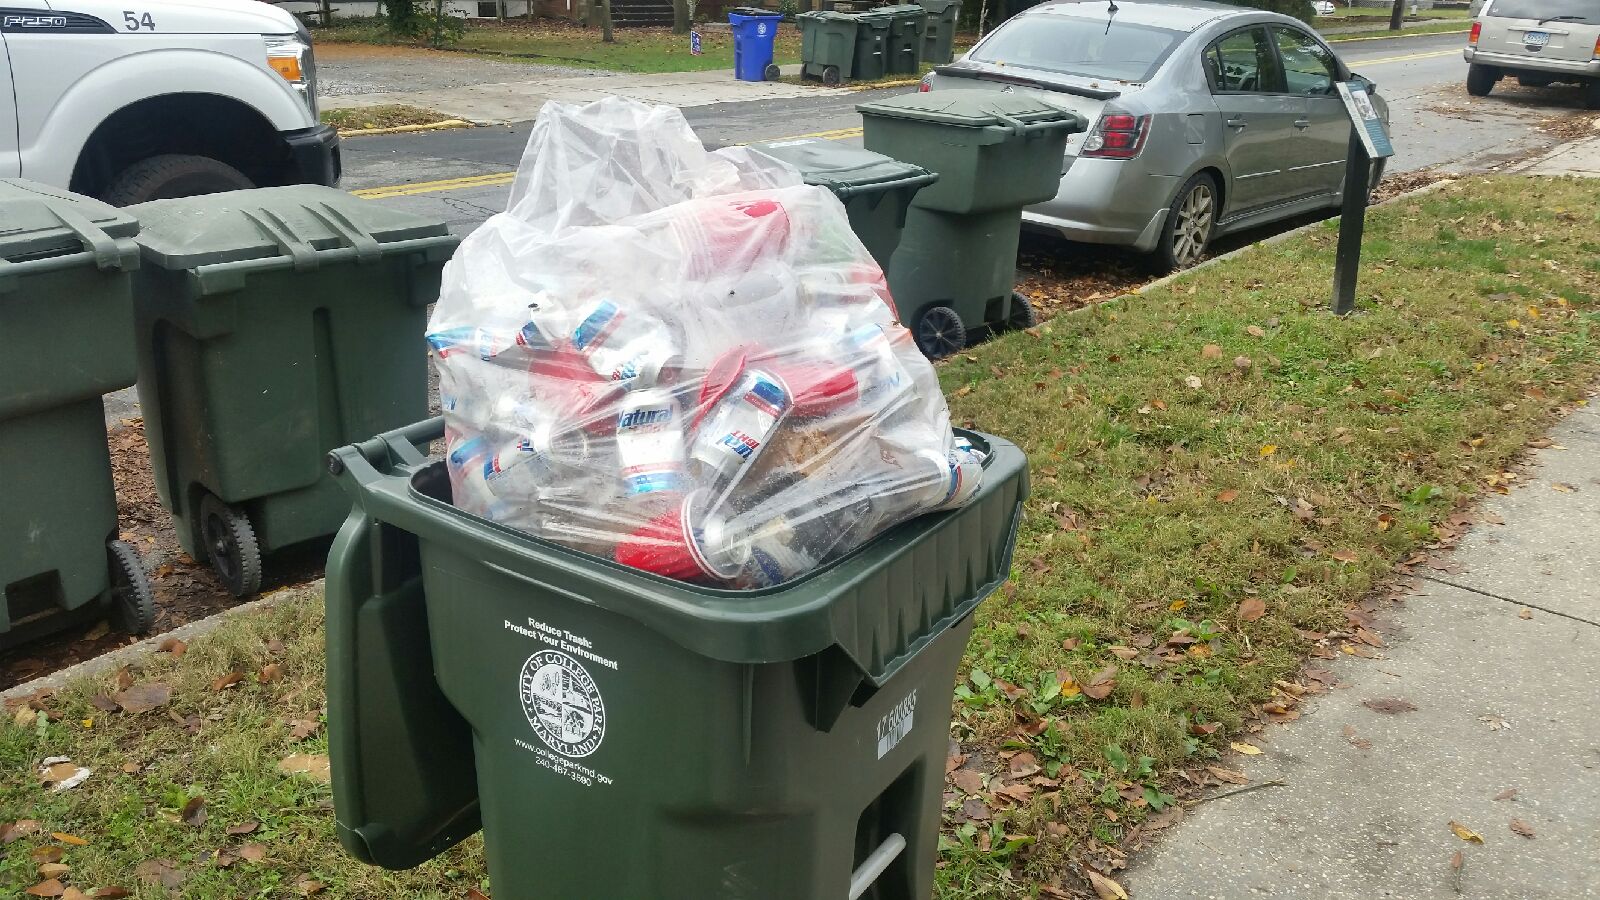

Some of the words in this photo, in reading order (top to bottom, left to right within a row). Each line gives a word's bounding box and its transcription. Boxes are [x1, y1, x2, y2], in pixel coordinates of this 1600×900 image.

[4, 15, 66, 28] F-250
[123, 10, 155, 31] 54
[504, 619, 537, 640] Protect
[538, 631, 559, 647] Your
[560, 639, 618, 670] Environment
[527, 617, 562, 638] Reduce
[563, 630, 593, 649] Trash:
[522, 670, 533, 704] CITY
[530, 655, 546, 672] OF
[545, 653, 595, 694] COLLEGE
[592, 698, 603, 734] PARK
[529, 715, 596, 755] MARYLAND
[514, 738, 614, 785] www.collegeparkmd.gov
[535, 756, 592, 787] 240-487-3590
